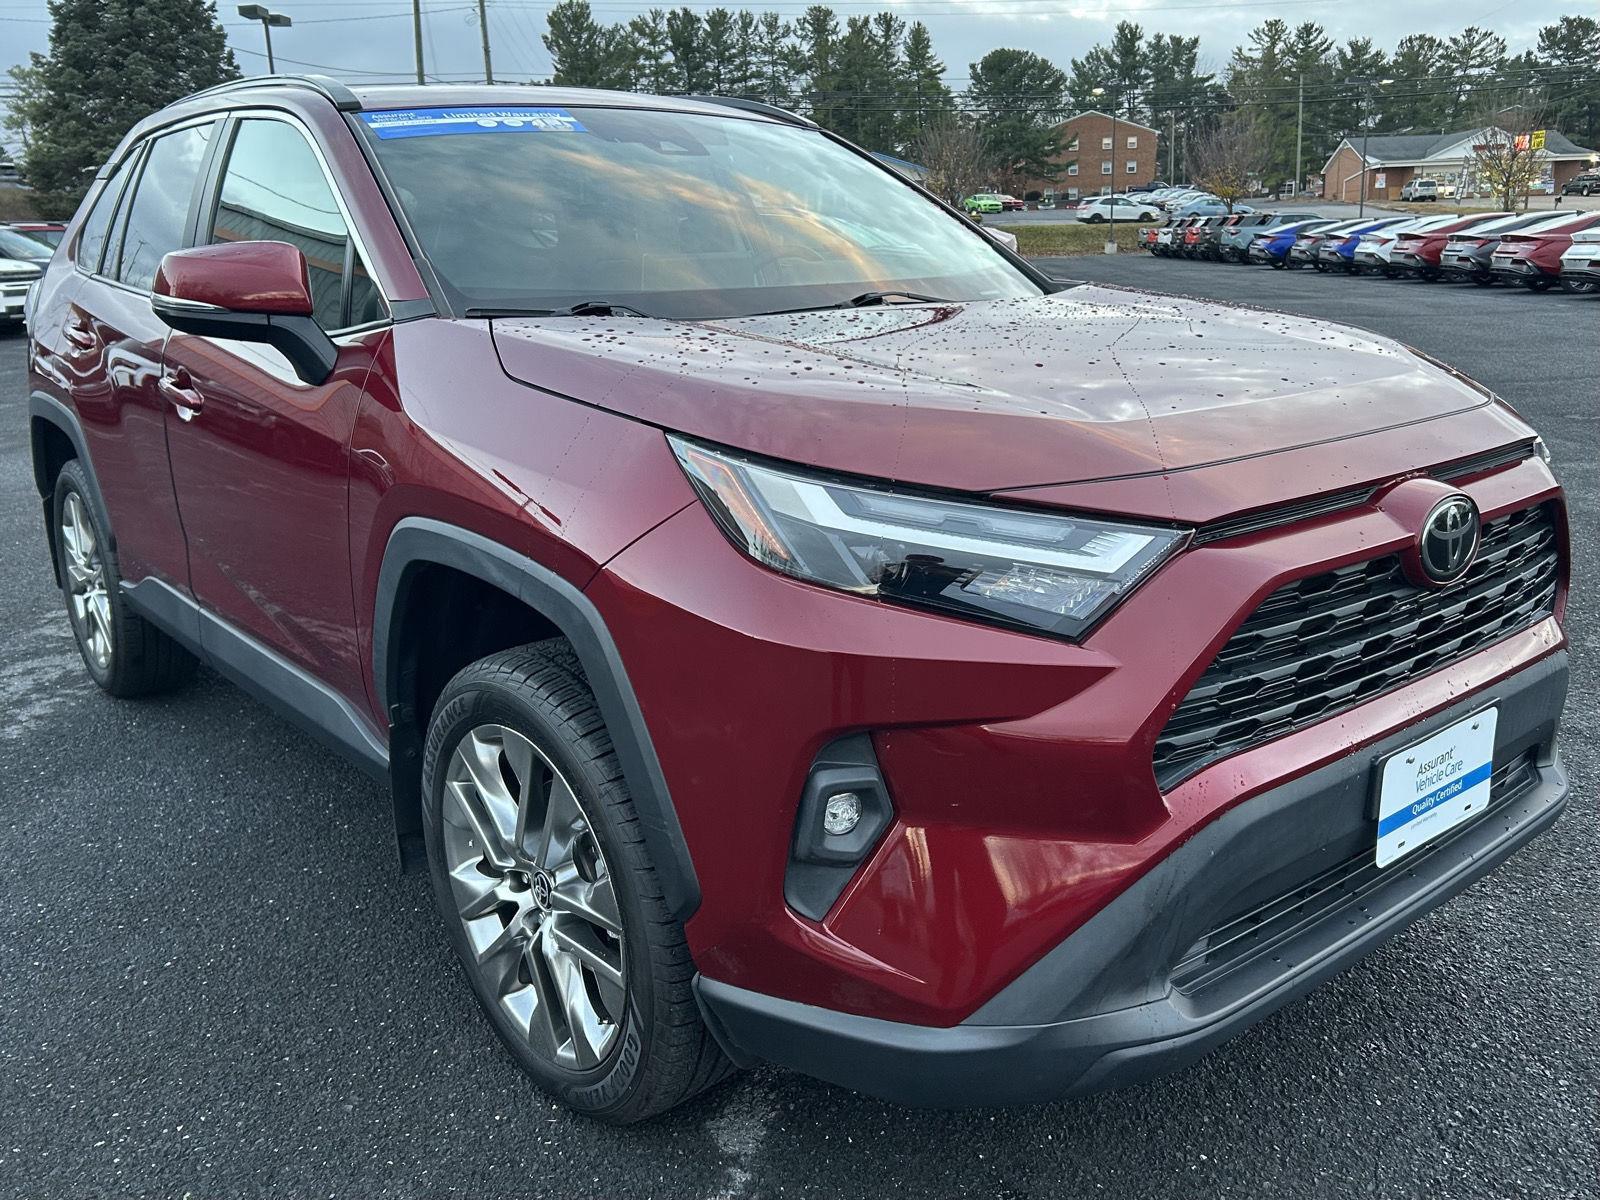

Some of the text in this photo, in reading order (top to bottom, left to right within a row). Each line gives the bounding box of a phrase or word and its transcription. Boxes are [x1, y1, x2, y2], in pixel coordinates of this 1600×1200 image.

[423, 695, 468, 786] ASSURANCE
[1415, 759, 1463, 794] Vehicle Care
[1416, 747, 1454, 778] Assurant
[1412, 796, 1435, 816] Quality
[1436, 779, 1463, 801] Certified
